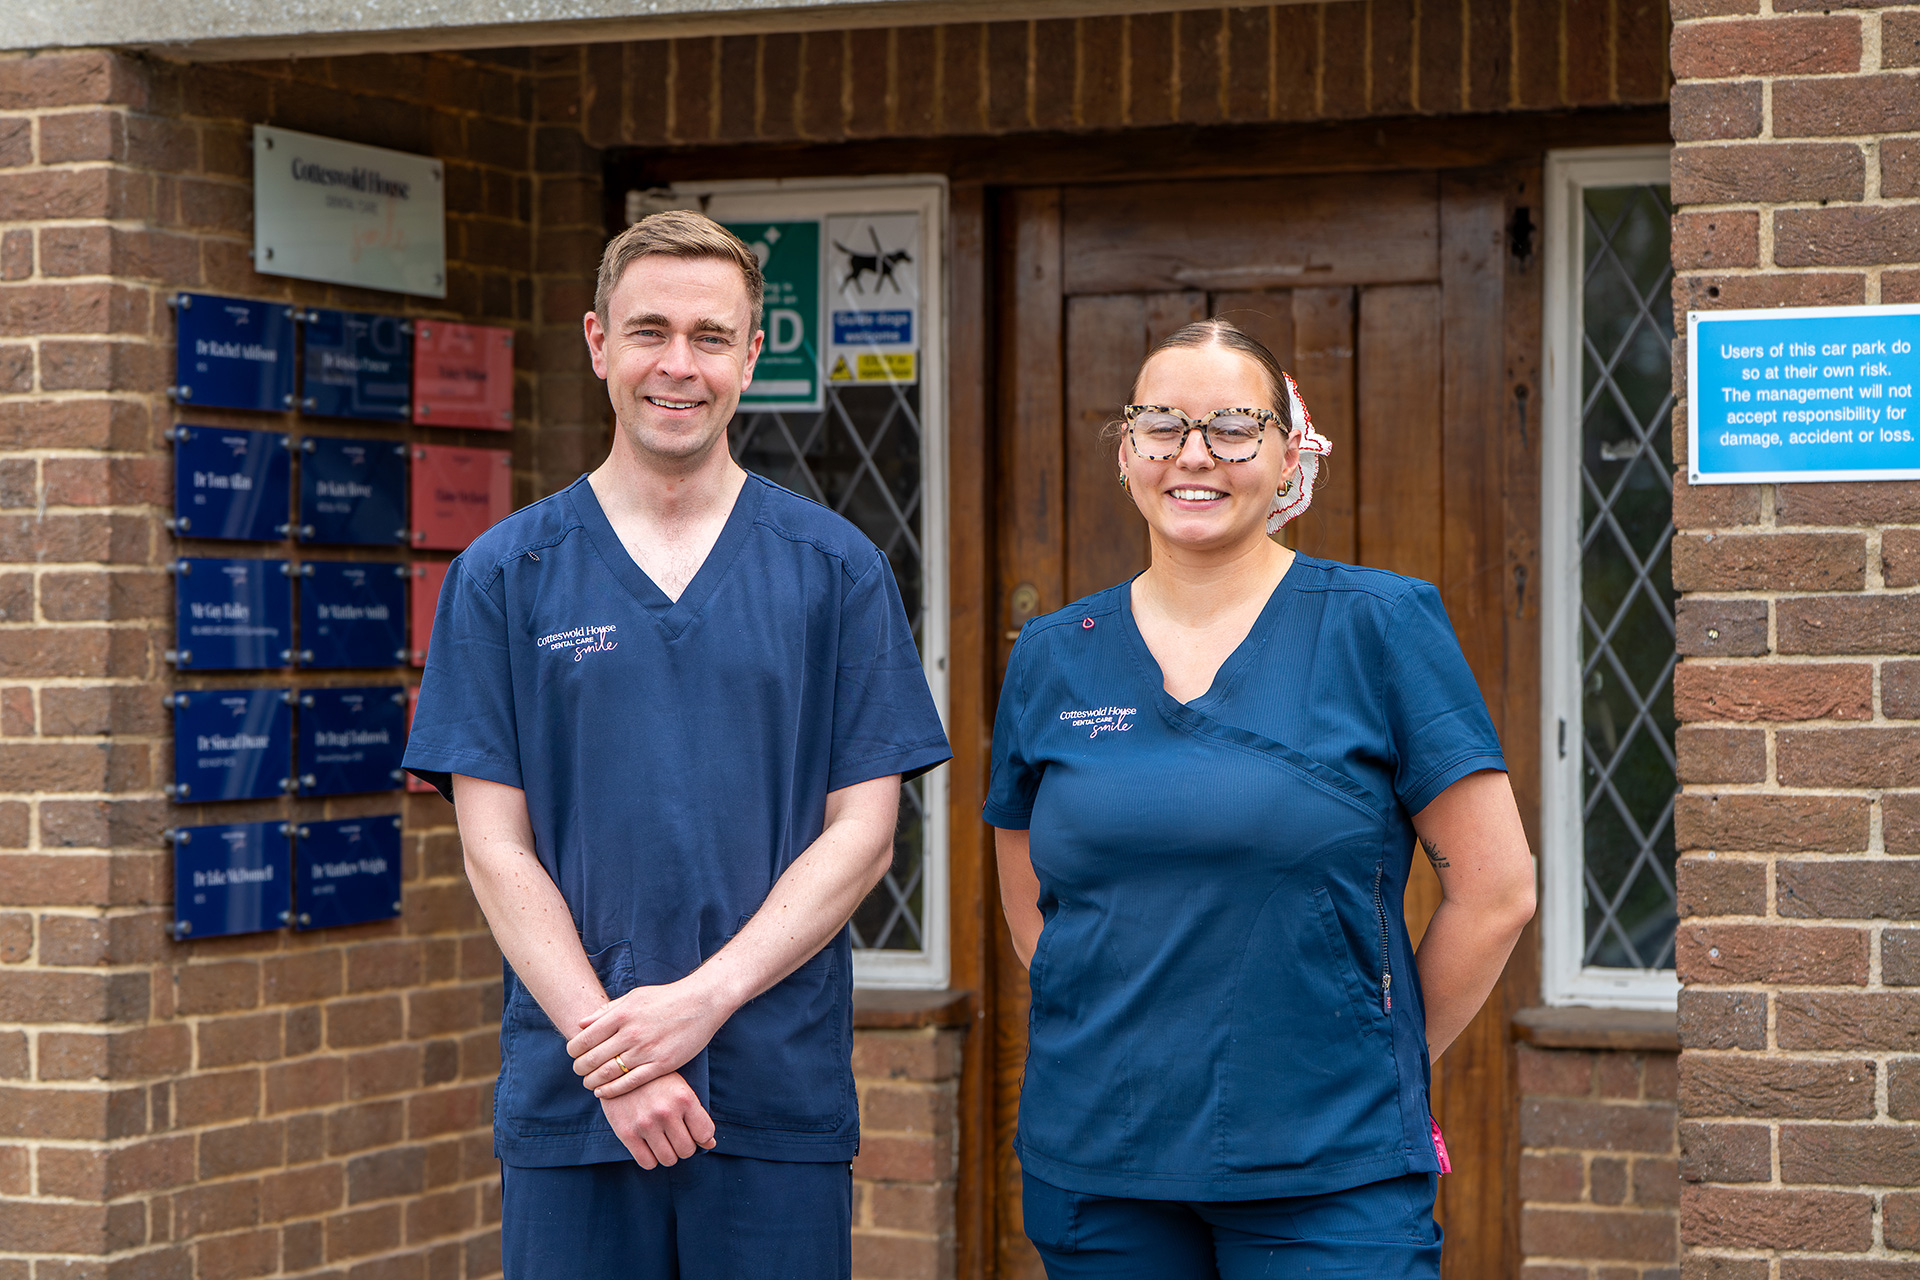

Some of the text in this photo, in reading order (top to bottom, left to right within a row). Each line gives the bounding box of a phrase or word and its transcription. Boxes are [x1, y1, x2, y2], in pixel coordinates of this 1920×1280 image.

[291, 157, 410, 200] Cotteswold House
[1720, 339, 1912, 359] Users of this car park do
[1742, 361, 1892, 380] so at their own risk.
[1721, 383, 1912, 405] The management will not
[1727, 405, 1907, 426] accept responsibility for
[1720, 427, 1915, 448] damage, accident or loss.
[537, 624, 617, 647] Cotteswold House
[550, 636, 594, 651] DENTAL CARE
[574, 632, 619, 662] smile
[1059, 706, 1137, 721] Cotteswold House
[1072, 718, 1096, 727] DENTAL
[1089, 714, 1134, 739] smile
